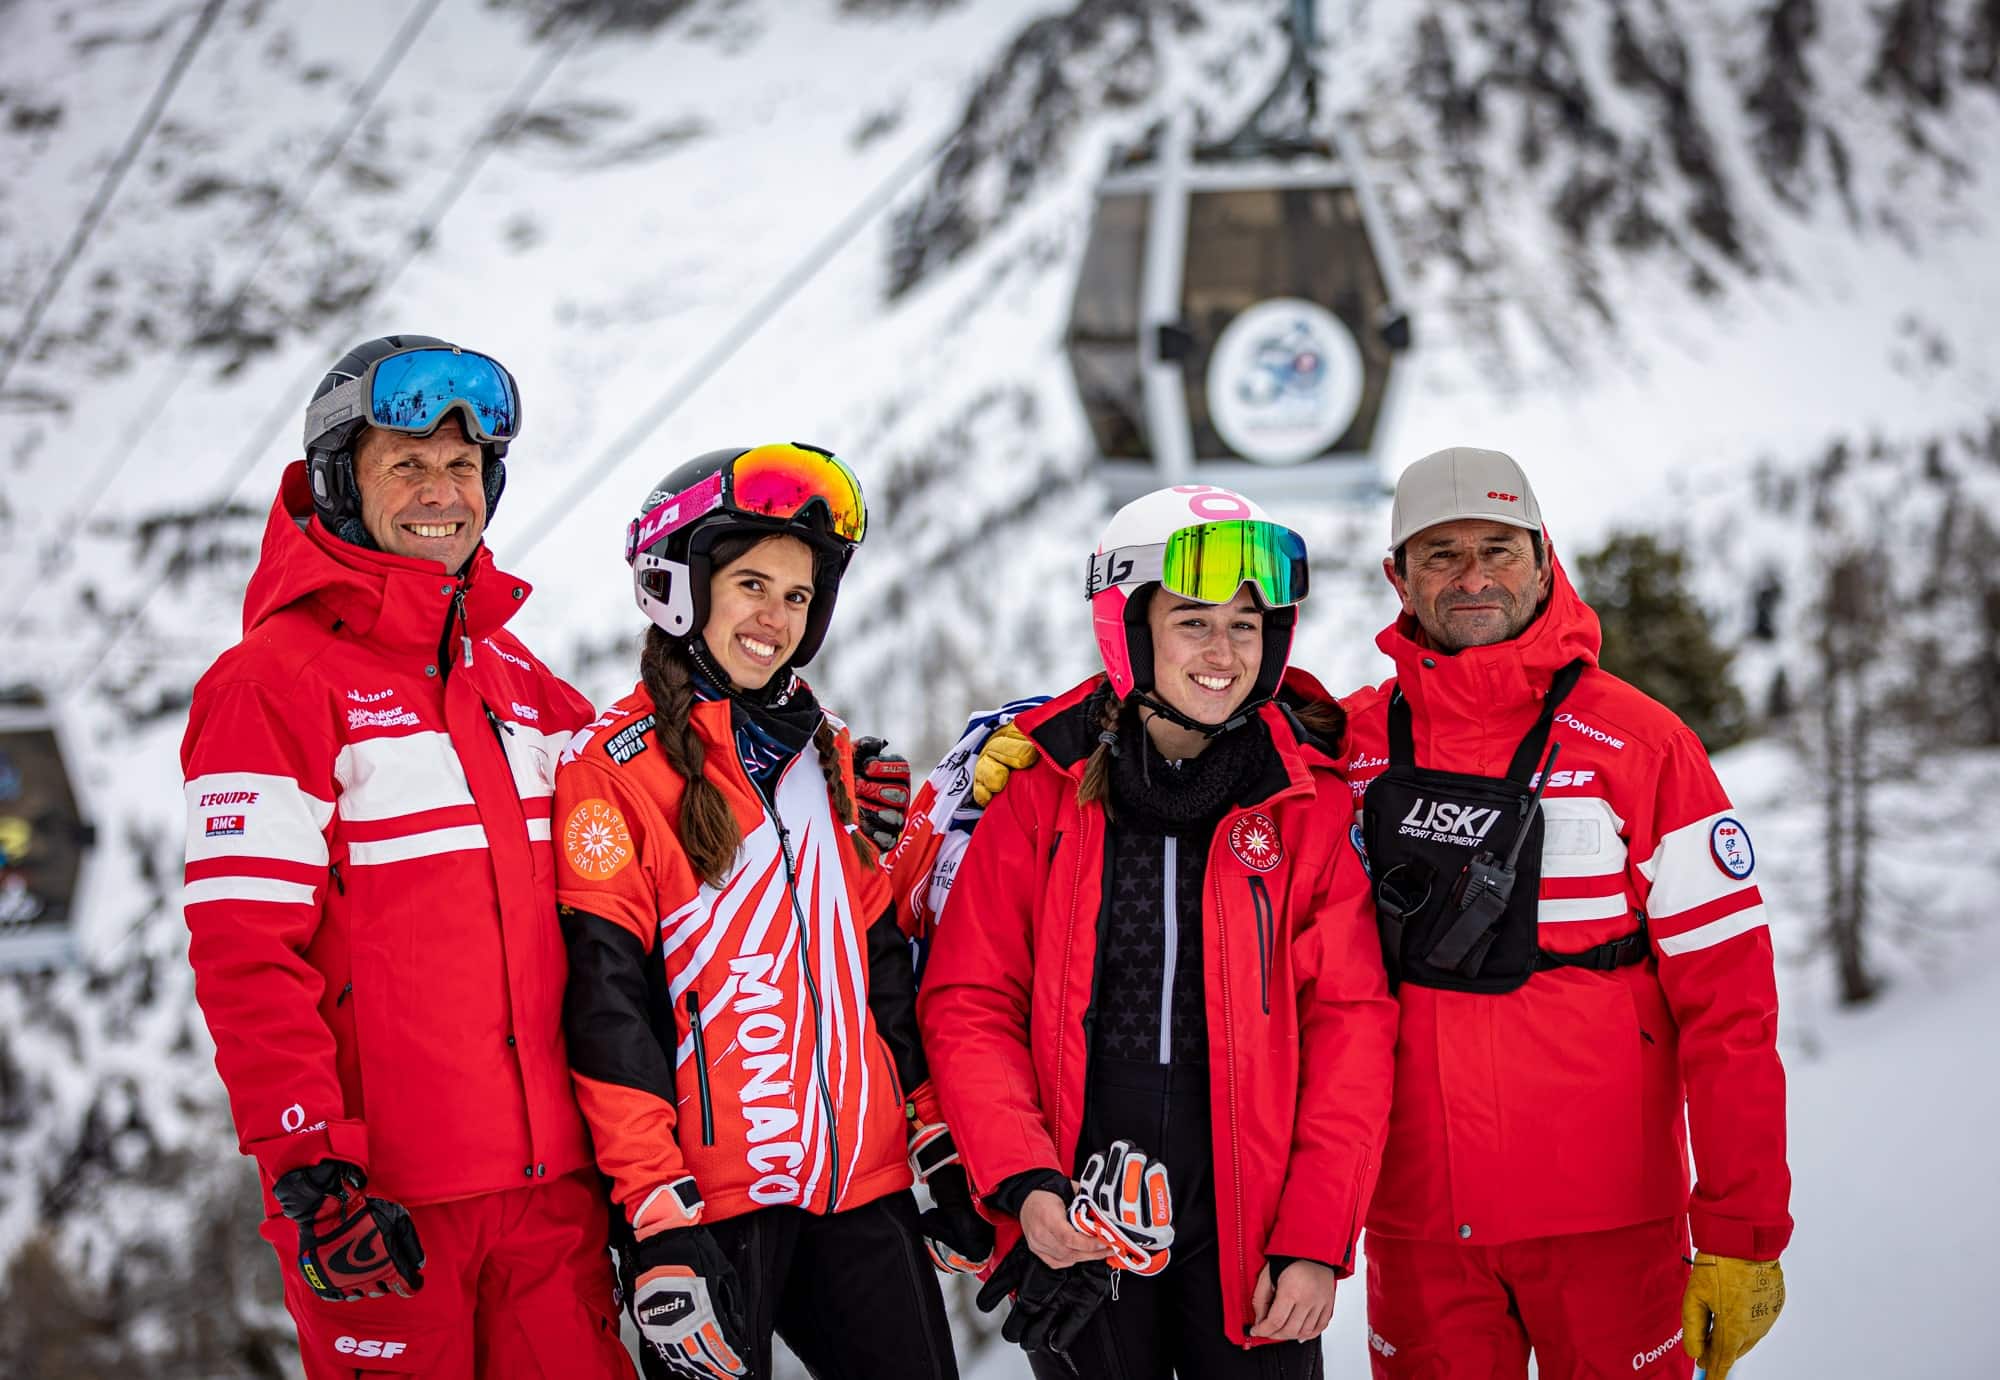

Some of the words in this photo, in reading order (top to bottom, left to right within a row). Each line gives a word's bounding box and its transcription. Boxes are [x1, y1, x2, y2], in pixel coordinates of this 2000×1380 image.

[606, 715, 656, 755] ENERGIA
[613, 737, 646, 766] PURA
[1370, 757, 1389, 768] 200
[200, 792, 260, 807] L'EQUIPE
[212, 817, 238, 830] RMC
[568, 807, 589, 852] MONTE
[593, 804, 629, 841] CARLO
[1401, 798, 1502, 838] LISKI
[1231, 816, 1250, 849] MONTE
[1255, 816, 1280, 849] CARLO
[1398, 825, 1432, 839] SPORT
[1431, 832, 1483, 848] EQUIPMENT
[574, 852, 594, 873] SKI
[599, 846, 626, 873] CLUB
[1240, 850, 1256, 866] SKI
[1257, 852, 1279, 868] CLUB
[728, 953, 805, 1204] MONACO
